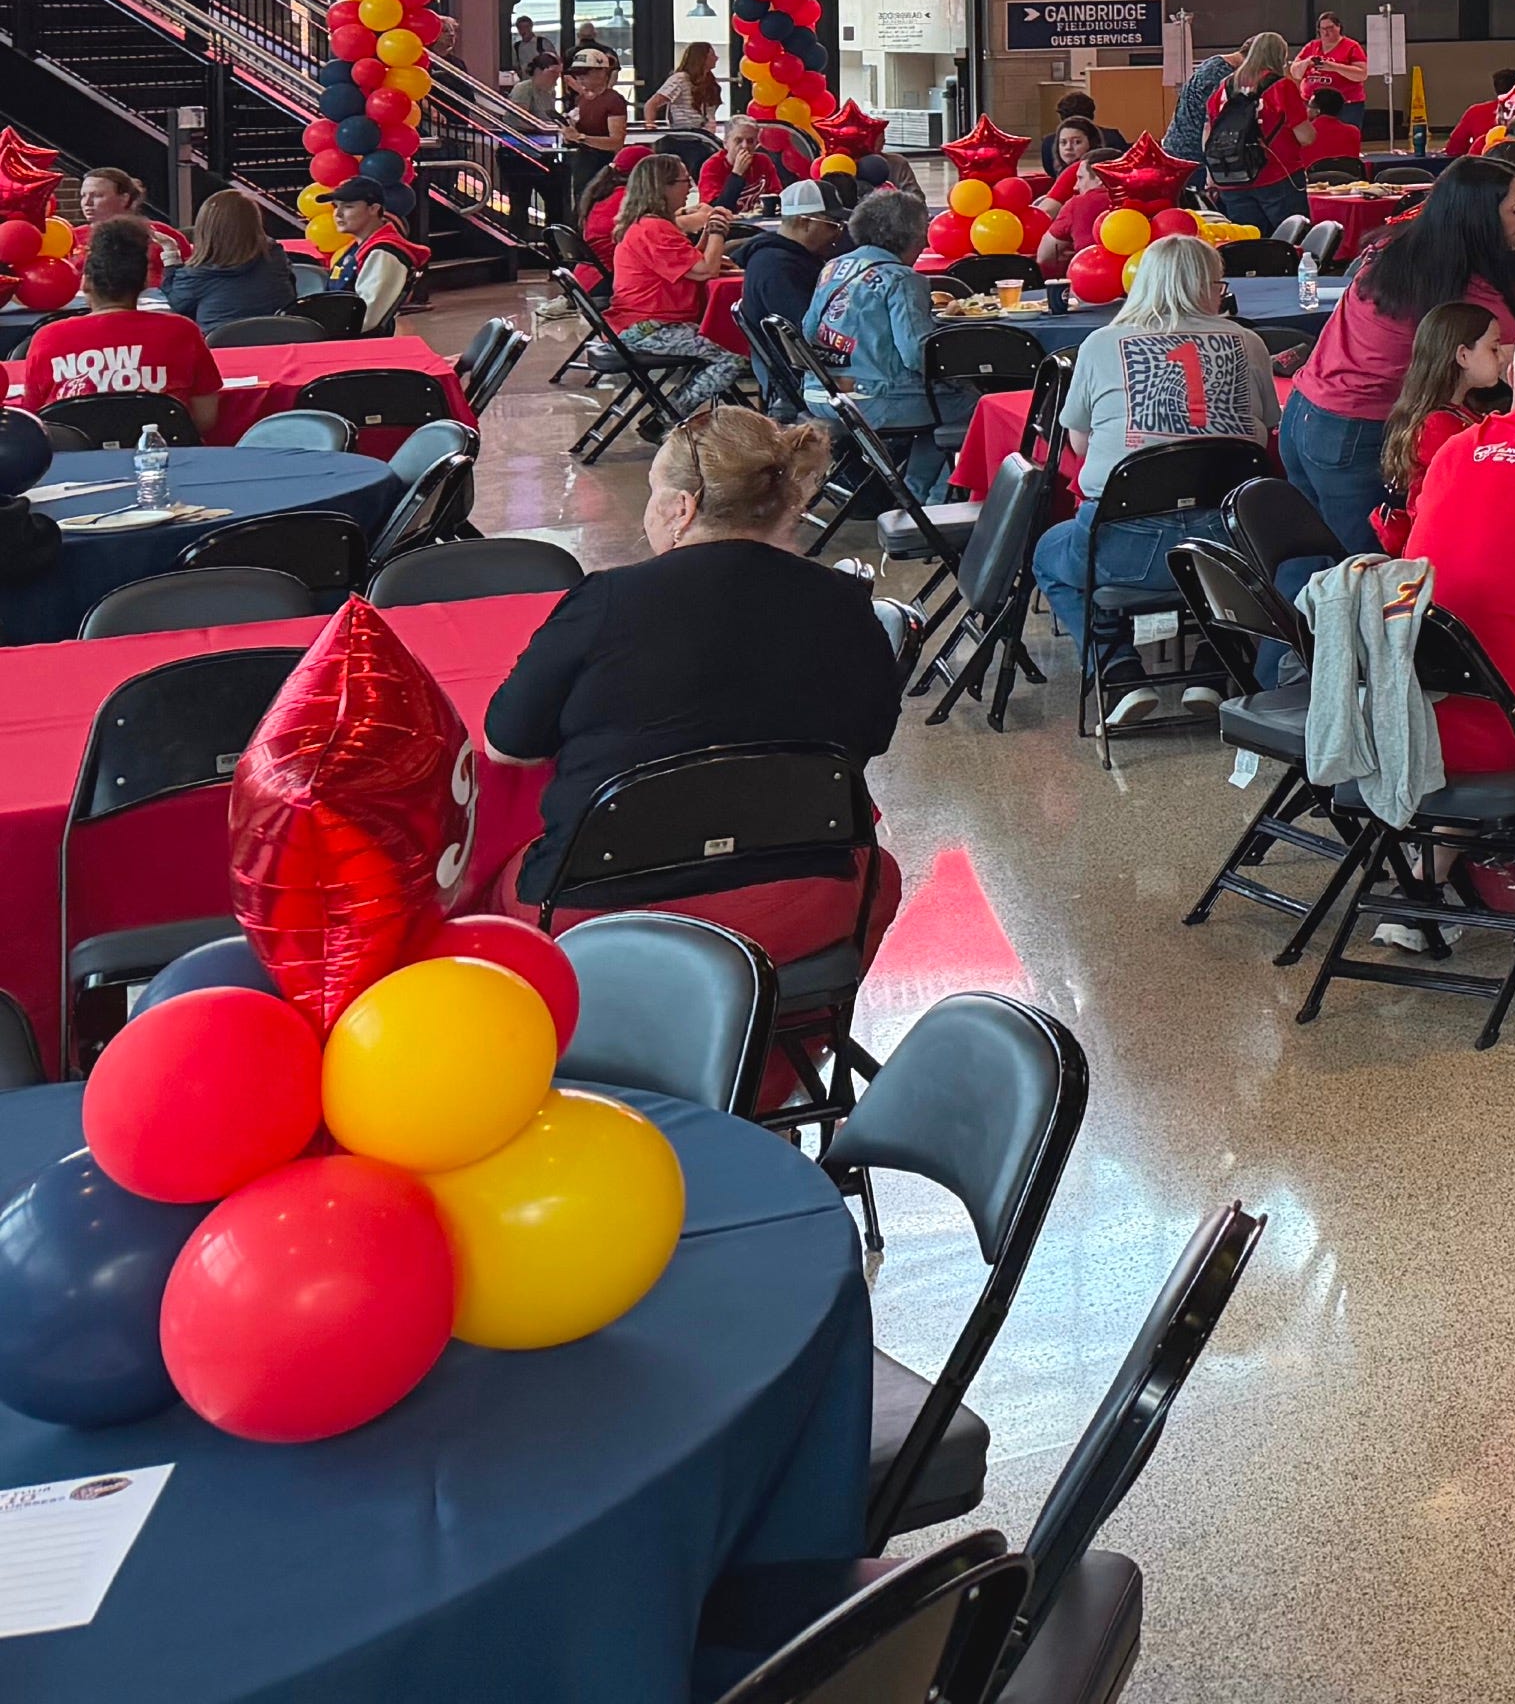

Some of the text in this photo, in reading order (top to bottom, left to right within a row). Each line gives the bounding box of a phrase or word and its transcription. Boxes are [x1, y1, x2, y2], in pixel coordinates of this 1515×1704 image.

[1044, 3, 1147, 22] GAINBRIDGE
[1056, 20, 1137, 32] FIELDHOUSE
[1050, 33, 1142, 47] GUEST SERVICES
[1123, 334, 1243, 354] NUMBER ONE
[51, 344, 143, 383] NOW
[88, 365, 167, 394] YOU
[1165, 340, 1208, 429] 1
